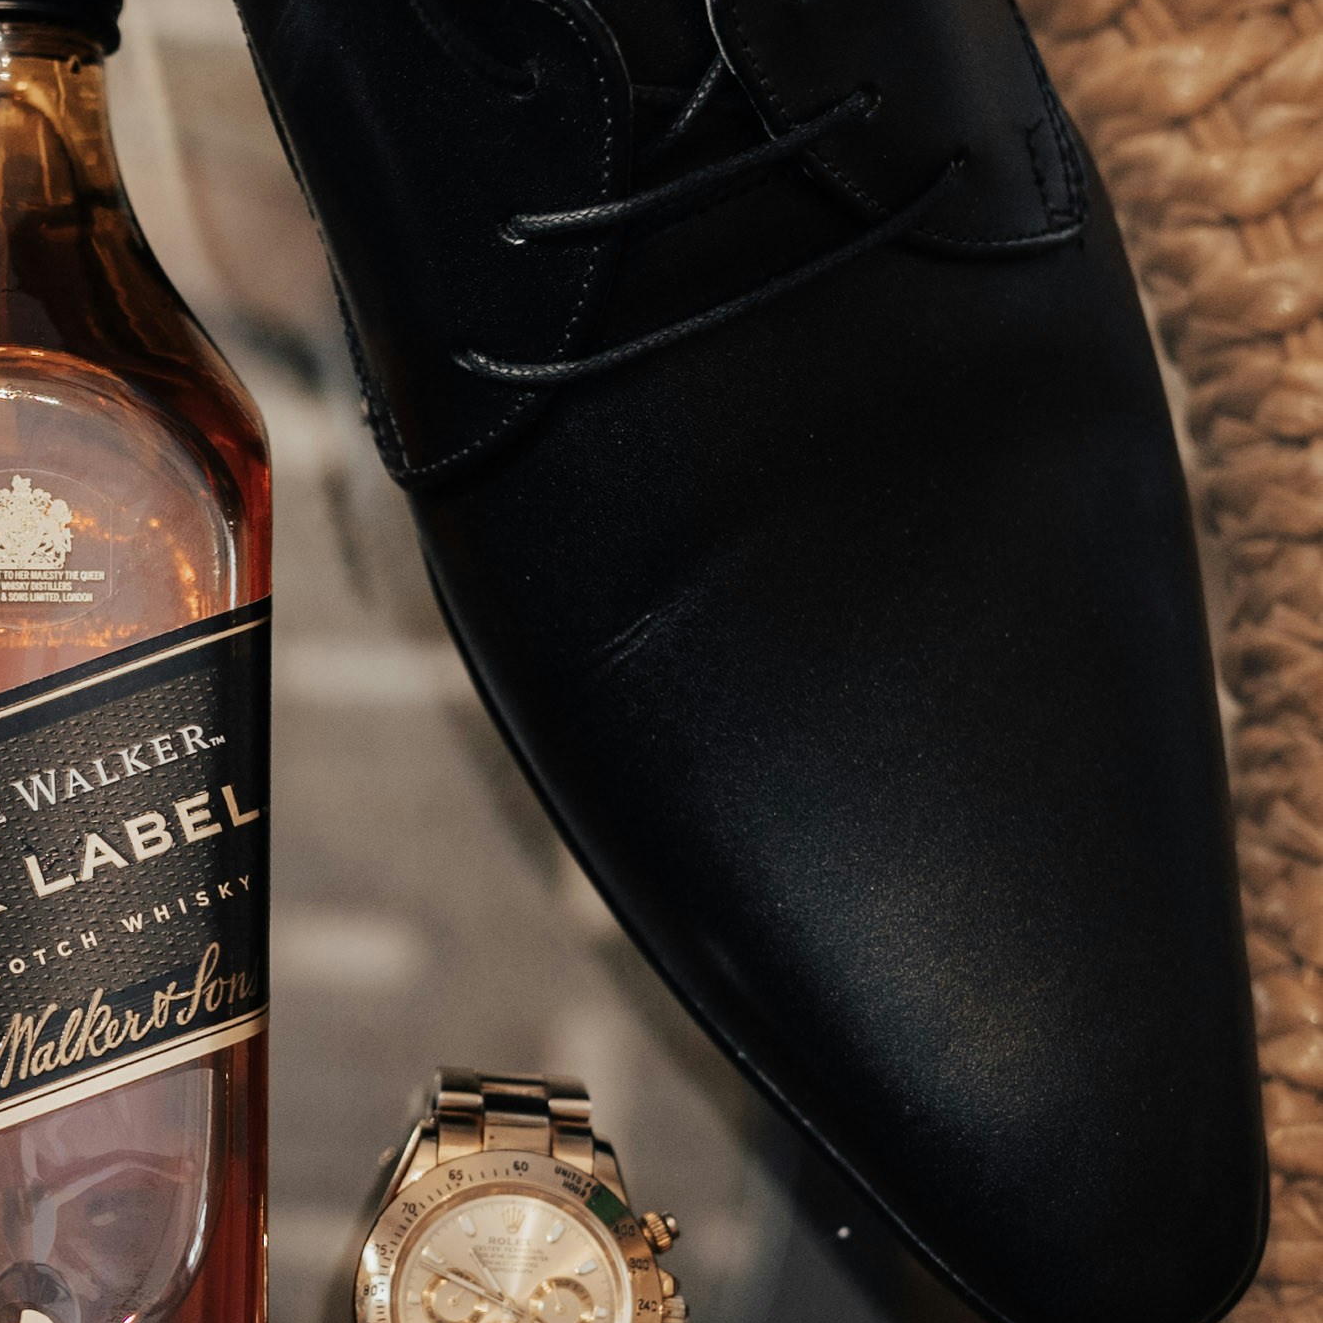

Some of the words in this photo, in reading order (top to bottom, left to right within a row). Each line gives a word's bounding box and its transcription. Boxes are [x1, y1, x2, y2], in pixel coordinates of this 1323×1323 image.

[23, 784, 261, 898] LABEL
[121, 875, 252, 934] WHISKY
[513, 1160, 529, 1172] 60
[448, 1169, 464, 1182] 65
[554, 1165, 583, 1185] UNITS
[401, 1202, 416, 1214] 70
[363, 1284, 377, 1296] 80
[637, 1298, 658, 1313] 240
